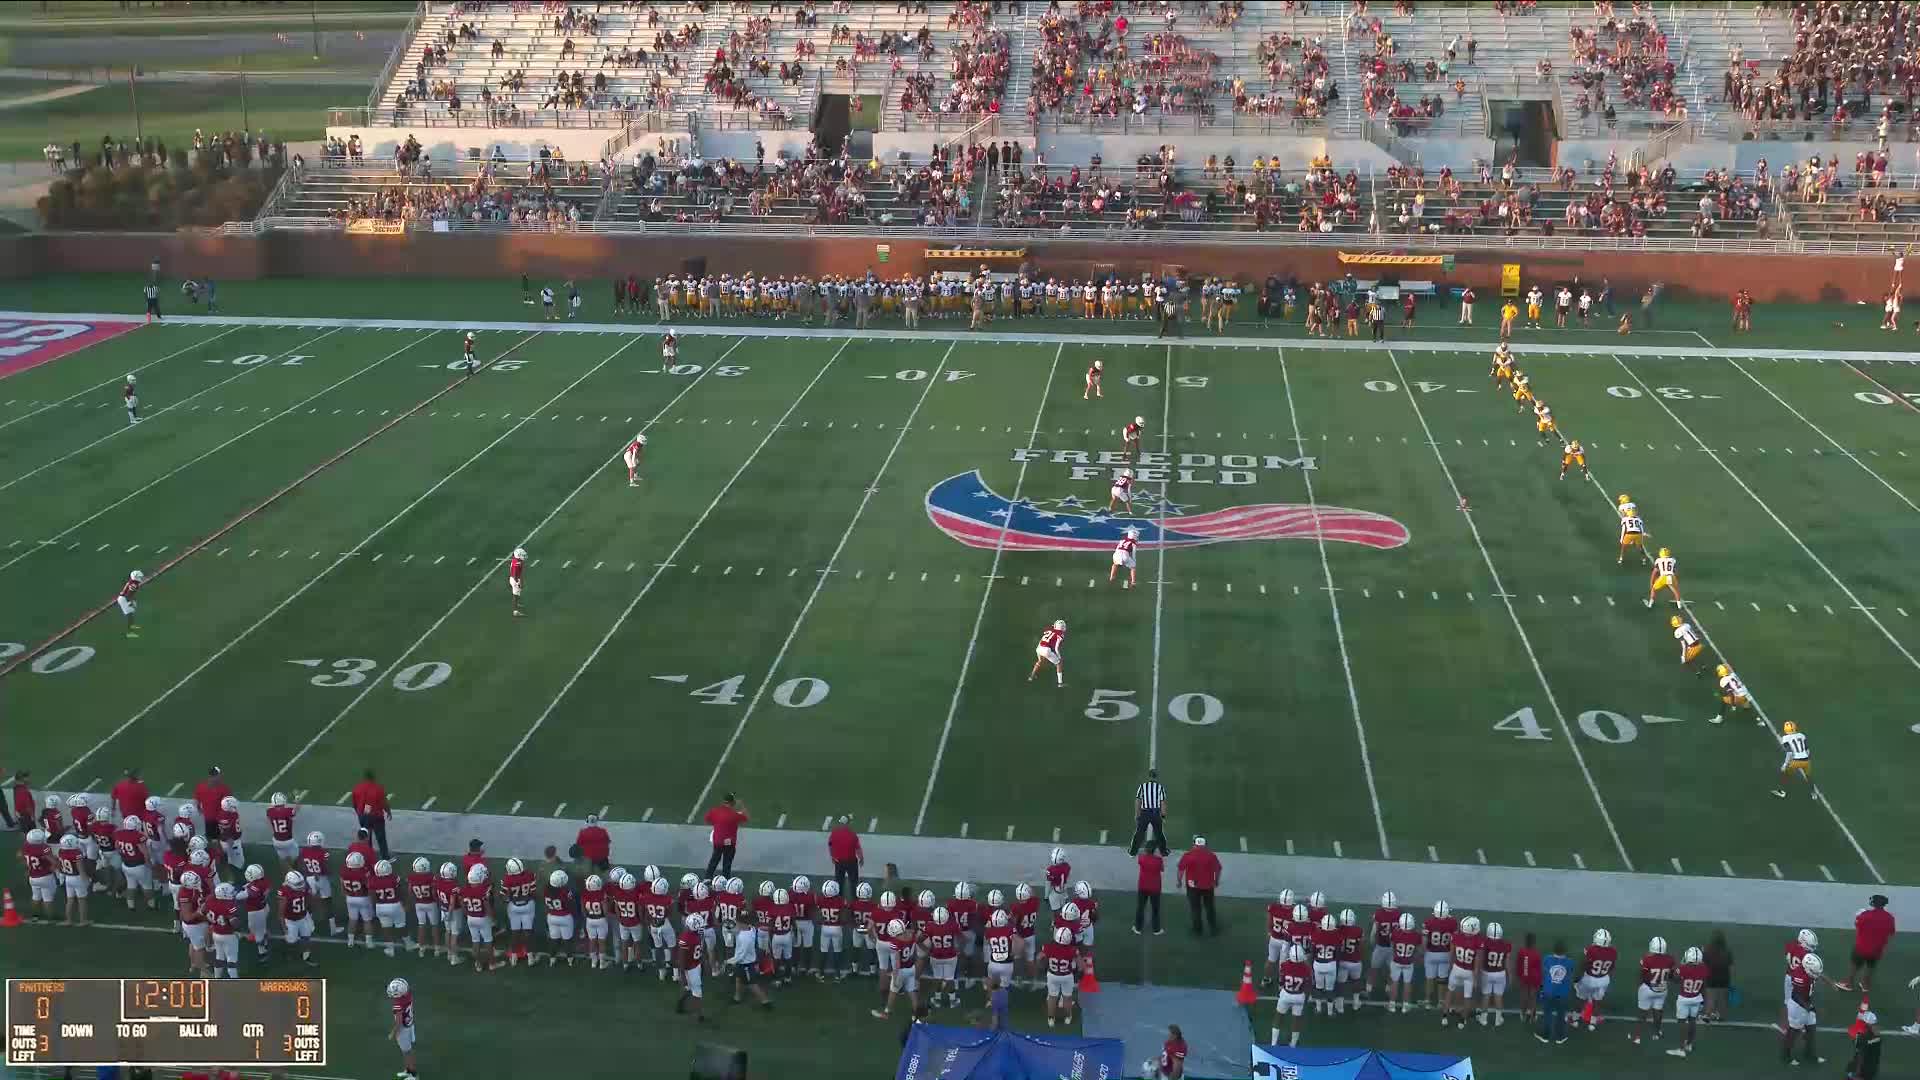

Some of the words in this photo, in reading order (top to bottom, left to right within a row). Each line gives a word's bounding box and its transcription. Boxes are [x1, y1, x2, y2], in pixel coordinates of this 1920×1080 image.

[1010, 448, 1321, 471] FREEDOM
[1069, 466, 1258, 486] FIELD
[1661, 560, 1672, 572] 16
[310, 658, 452, 691] 30
[689, 674, 830, 708] 40
[1084, 689, 1224, 725] 50
[1492, 707, 1638, 744] 40
[1791, 738, 1804, 754] 17
[272, 819, 288, 833] 12
[376, 887, 395, 900] 73
[511, 883, 529, 897] 78
[293, 897, 306, 912] 51
[619, 902, 635, 917] 59
[774, 916, 791, 931] 43
[1285, 976, 1304, 992] 27
